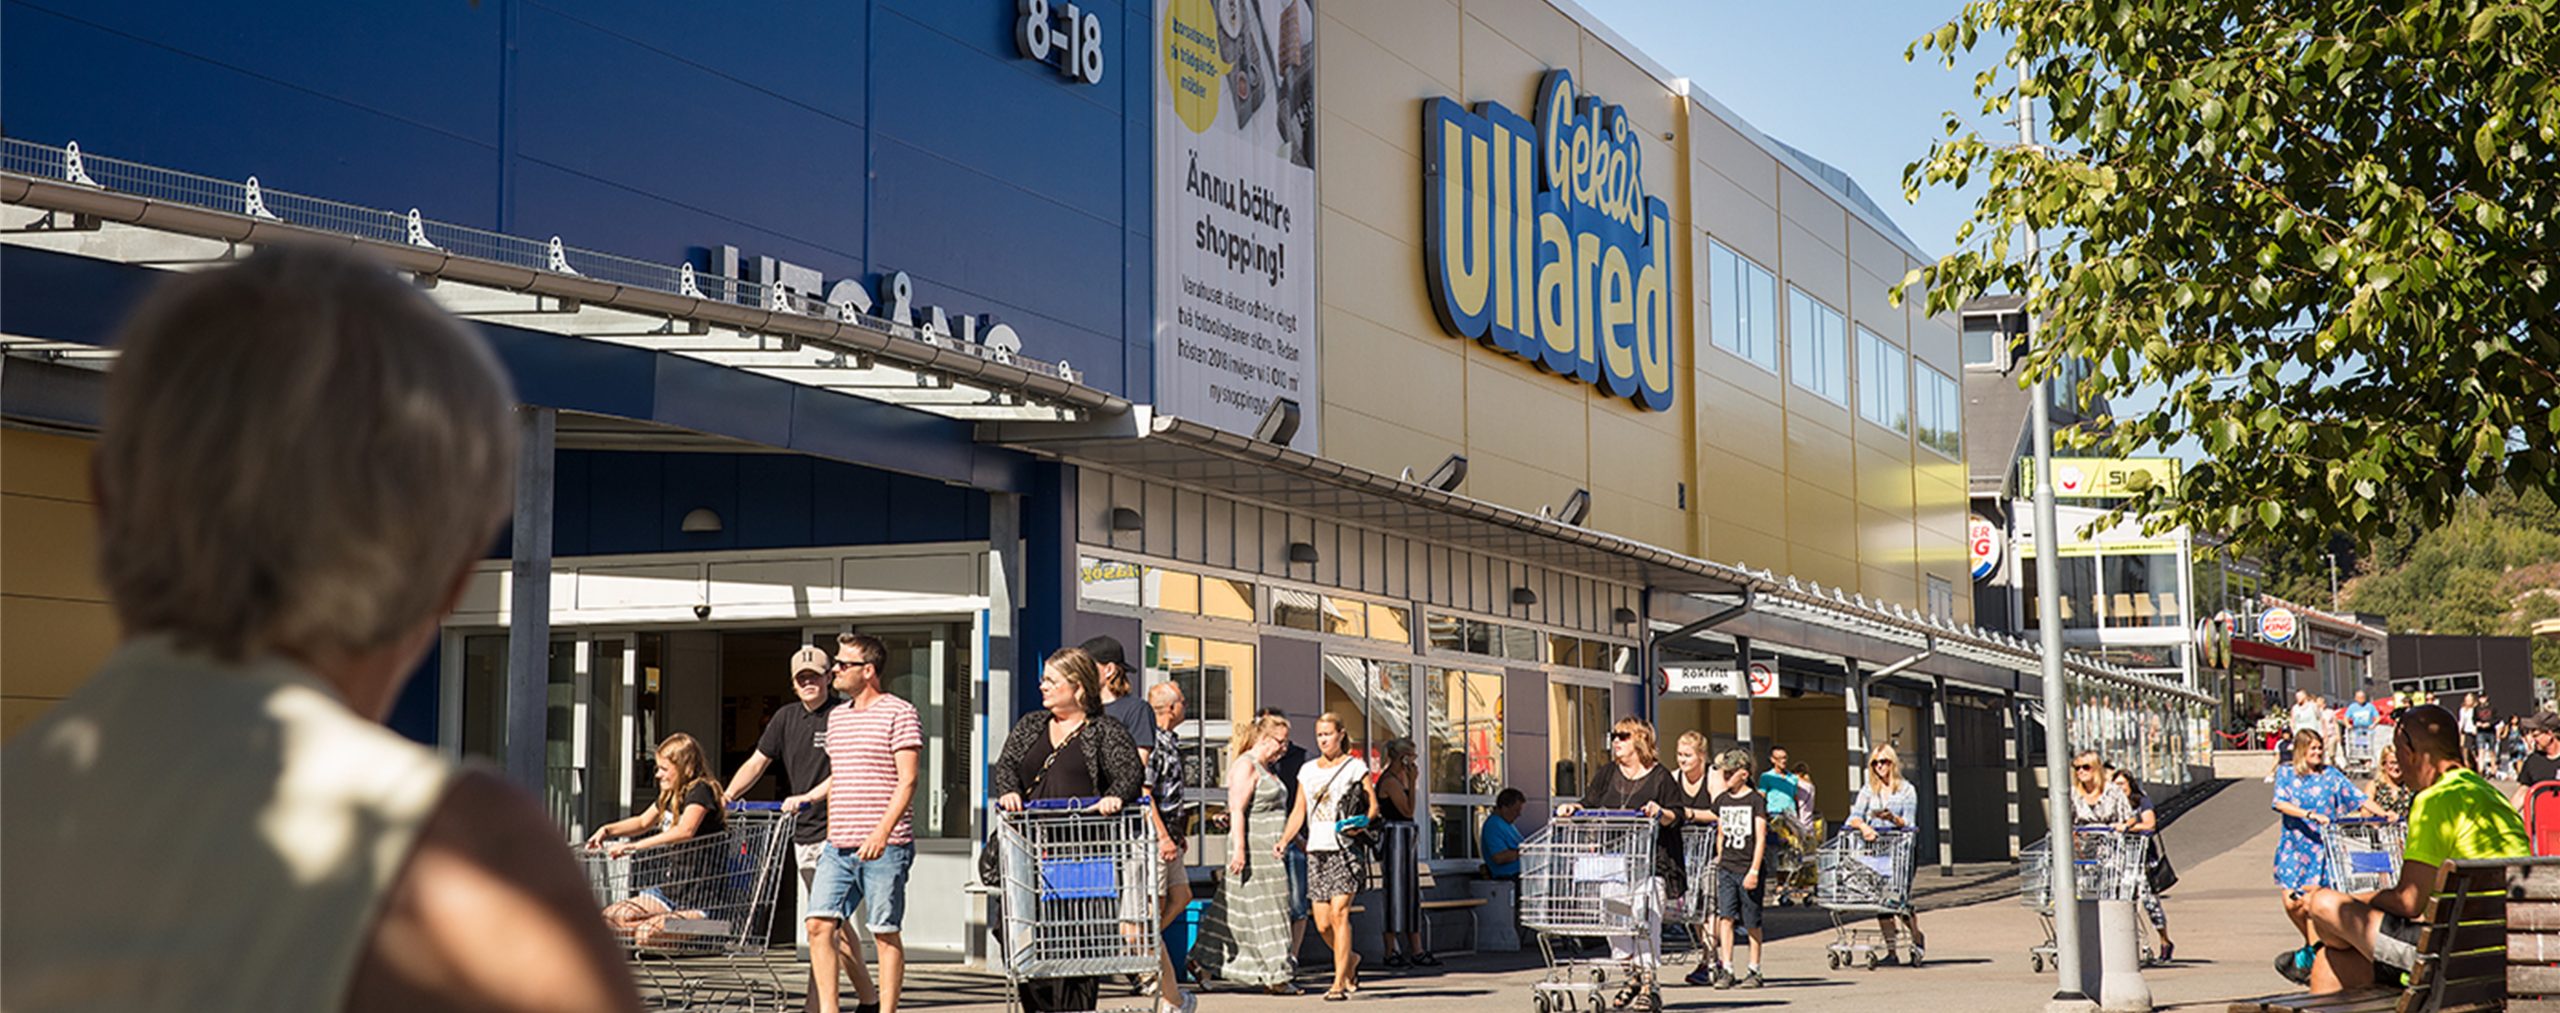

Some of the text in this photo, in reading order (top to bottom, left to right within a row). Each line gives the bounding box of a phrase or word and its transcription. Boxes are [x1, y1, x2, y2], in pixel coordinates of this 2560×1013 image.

[1186, 149, 1291, 234] Ännu bättre
[1548, 79, 1644, 236] Gekås
[1196, 214, 1285, 287] shopping!
[1444, 118, 1670, 394] Ullared
